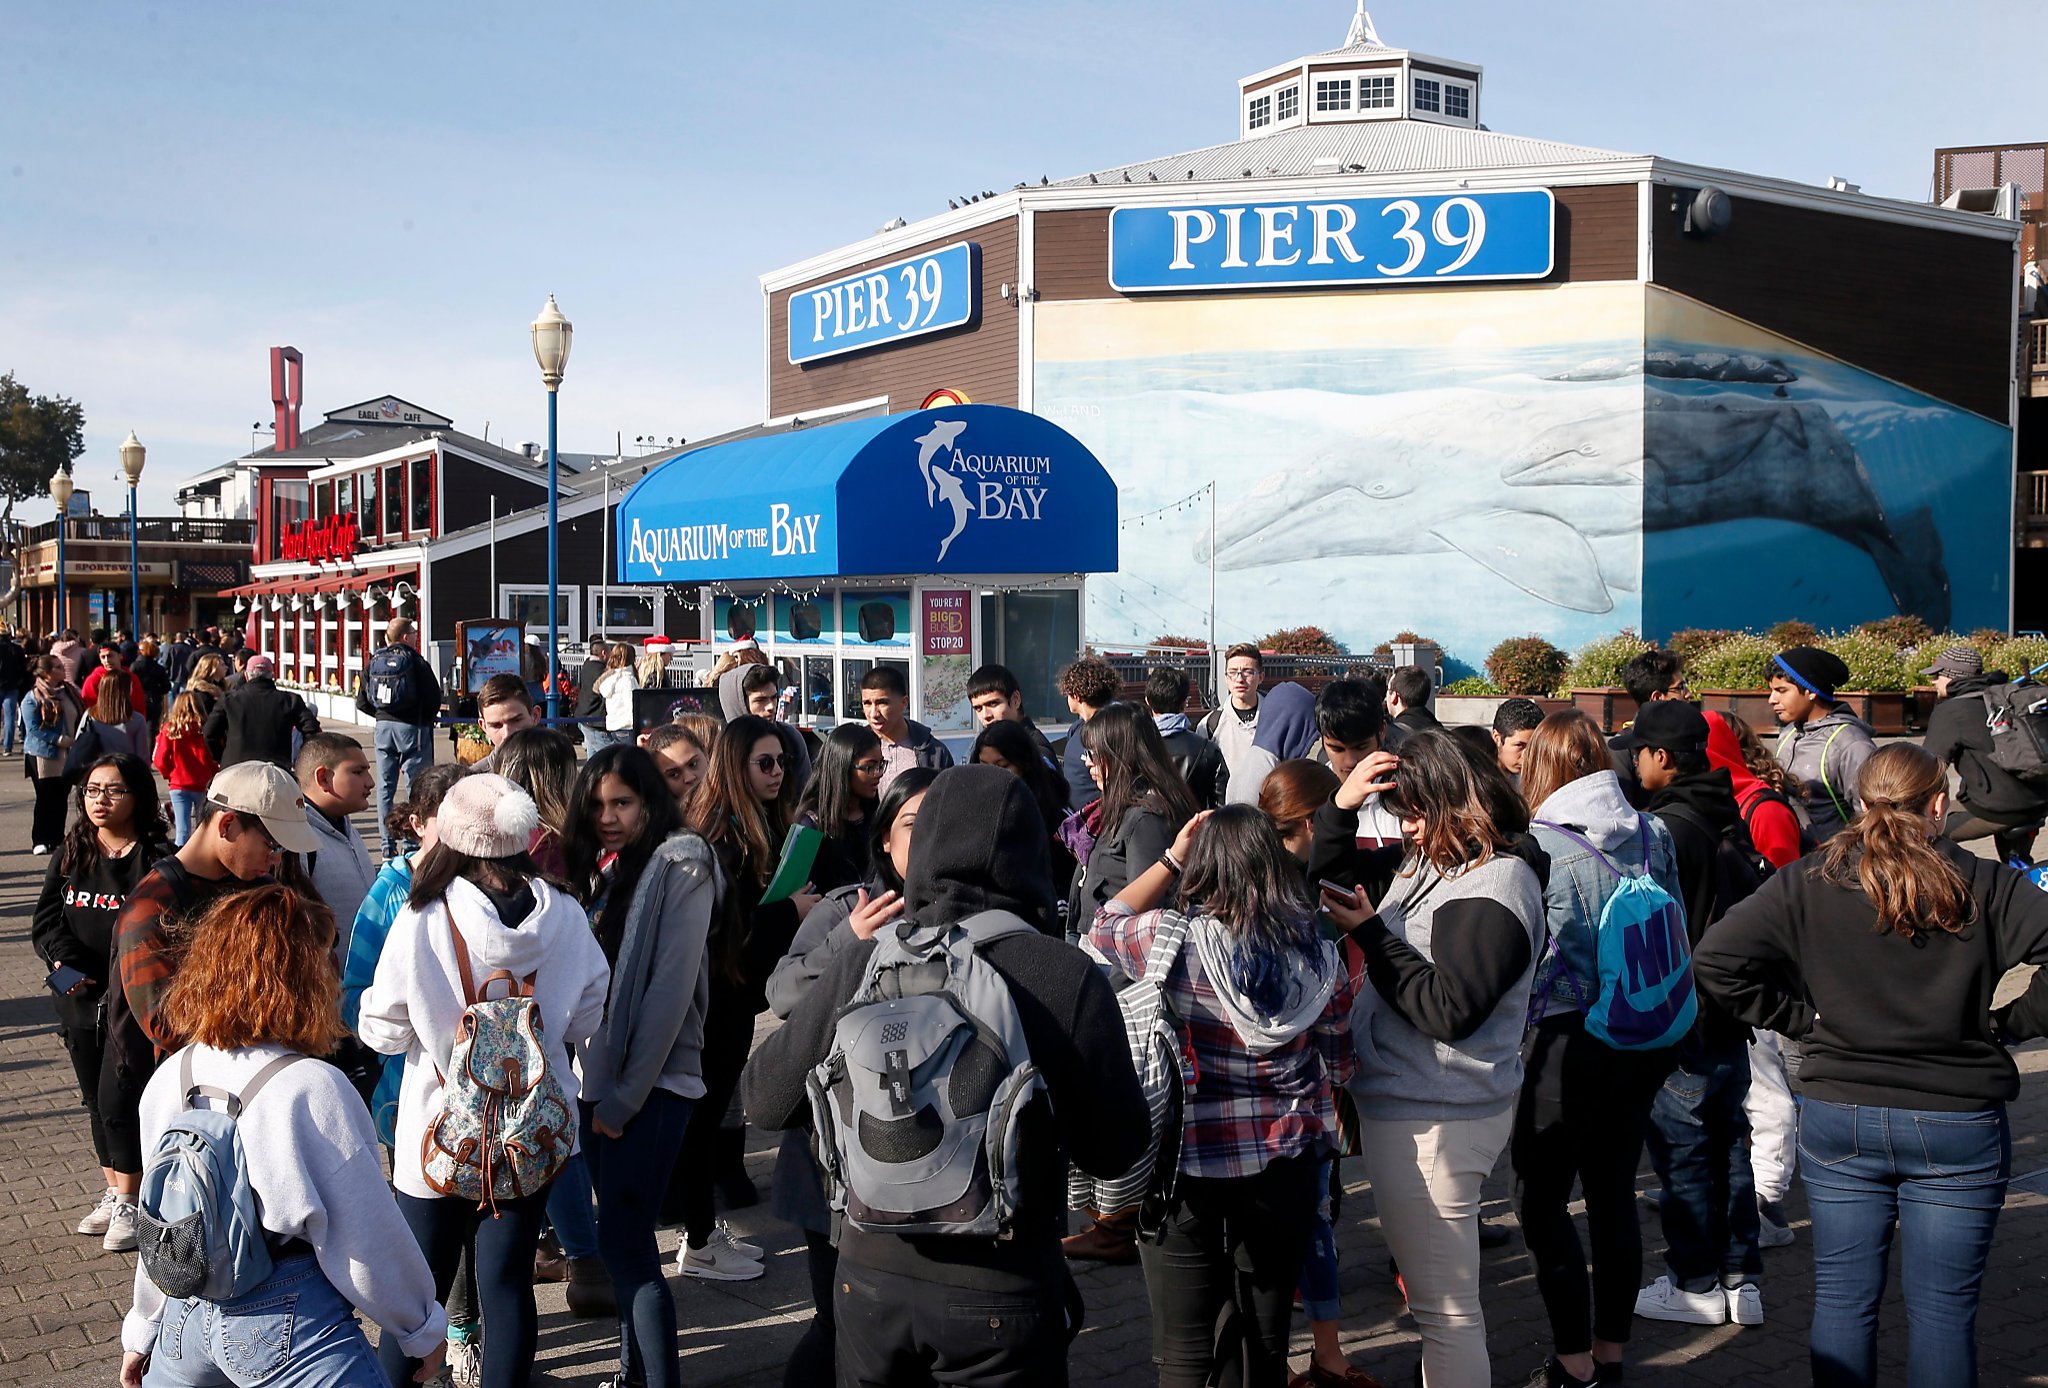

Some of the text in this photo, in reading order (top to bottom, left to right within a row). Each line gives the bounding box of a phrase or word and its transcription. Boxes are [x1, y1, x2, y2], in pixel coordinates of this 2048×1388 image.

[1168, 197, 1487, 276] PIER 39
[812, 258, 943, 343] PIER 39
[358, 410, 421, 422] EAGLE CAFE
[949, 448, 1050, 479] AQUARIUM
[1005, 475, 1040, 485] OF THE
[977, 482, 1048, 520] BAY
[282, 512, 355, 566] Hard Rock Cafe
[628, 503, 821, 577] AQUARIUM OF THE BAY
[929, 598, 962, 608] YOU'RE AT
[930, 611, 949, 622] BIG
[930, 622, 949, 633] BUS
[930, 637, 963, 649] STOP 20
